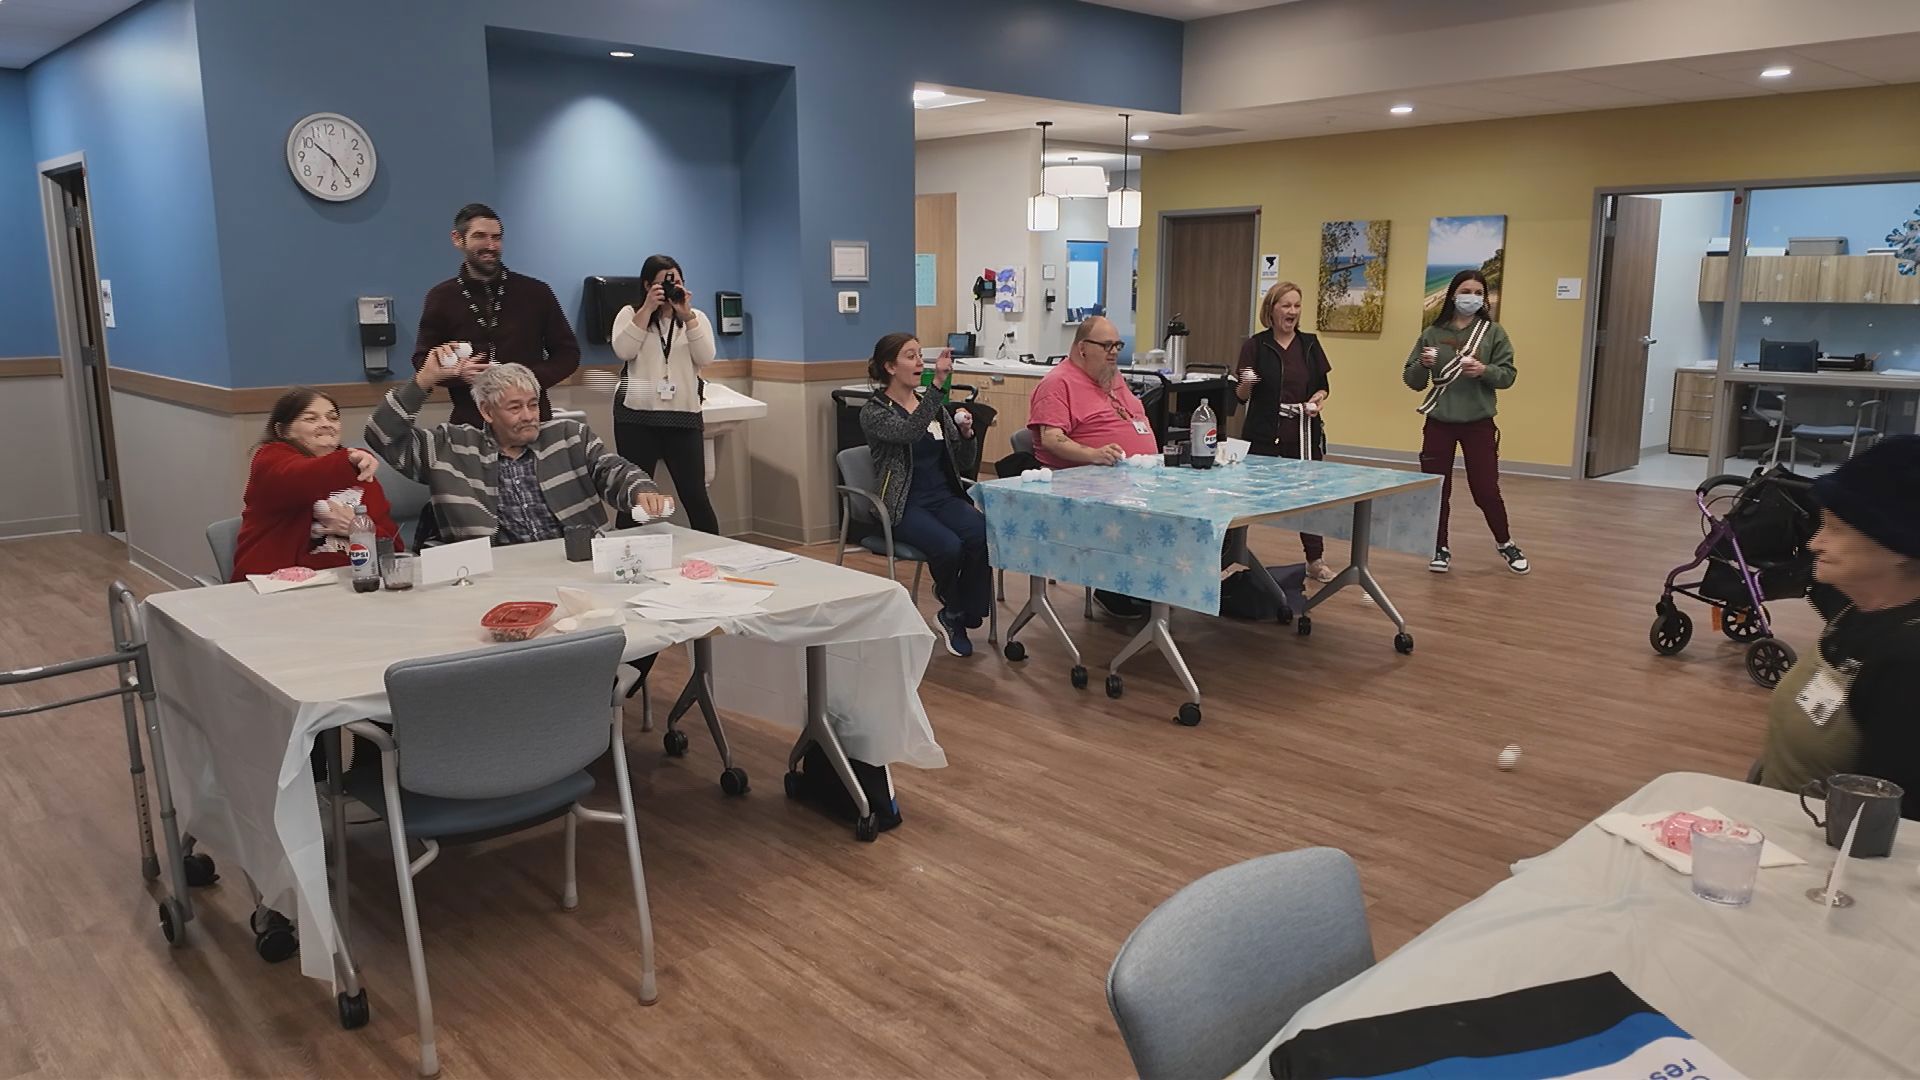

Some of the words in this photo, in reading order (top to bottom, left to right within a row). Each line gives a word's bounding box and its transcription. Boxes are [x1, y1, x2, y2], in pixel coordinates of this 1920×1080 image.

[323, 123, 335, 136] 12
[302, 136, 314, 149] 10
[351, 138, 359, 151] 2
[297, 150, 306, 163] 9
[356, 152, 365, 165] 3
[303, 164, 312, 177] 8
[352, 167, 361, 178] 4
[316, 175, 324, 187] 7
[330, 180, 338, 192] 6
